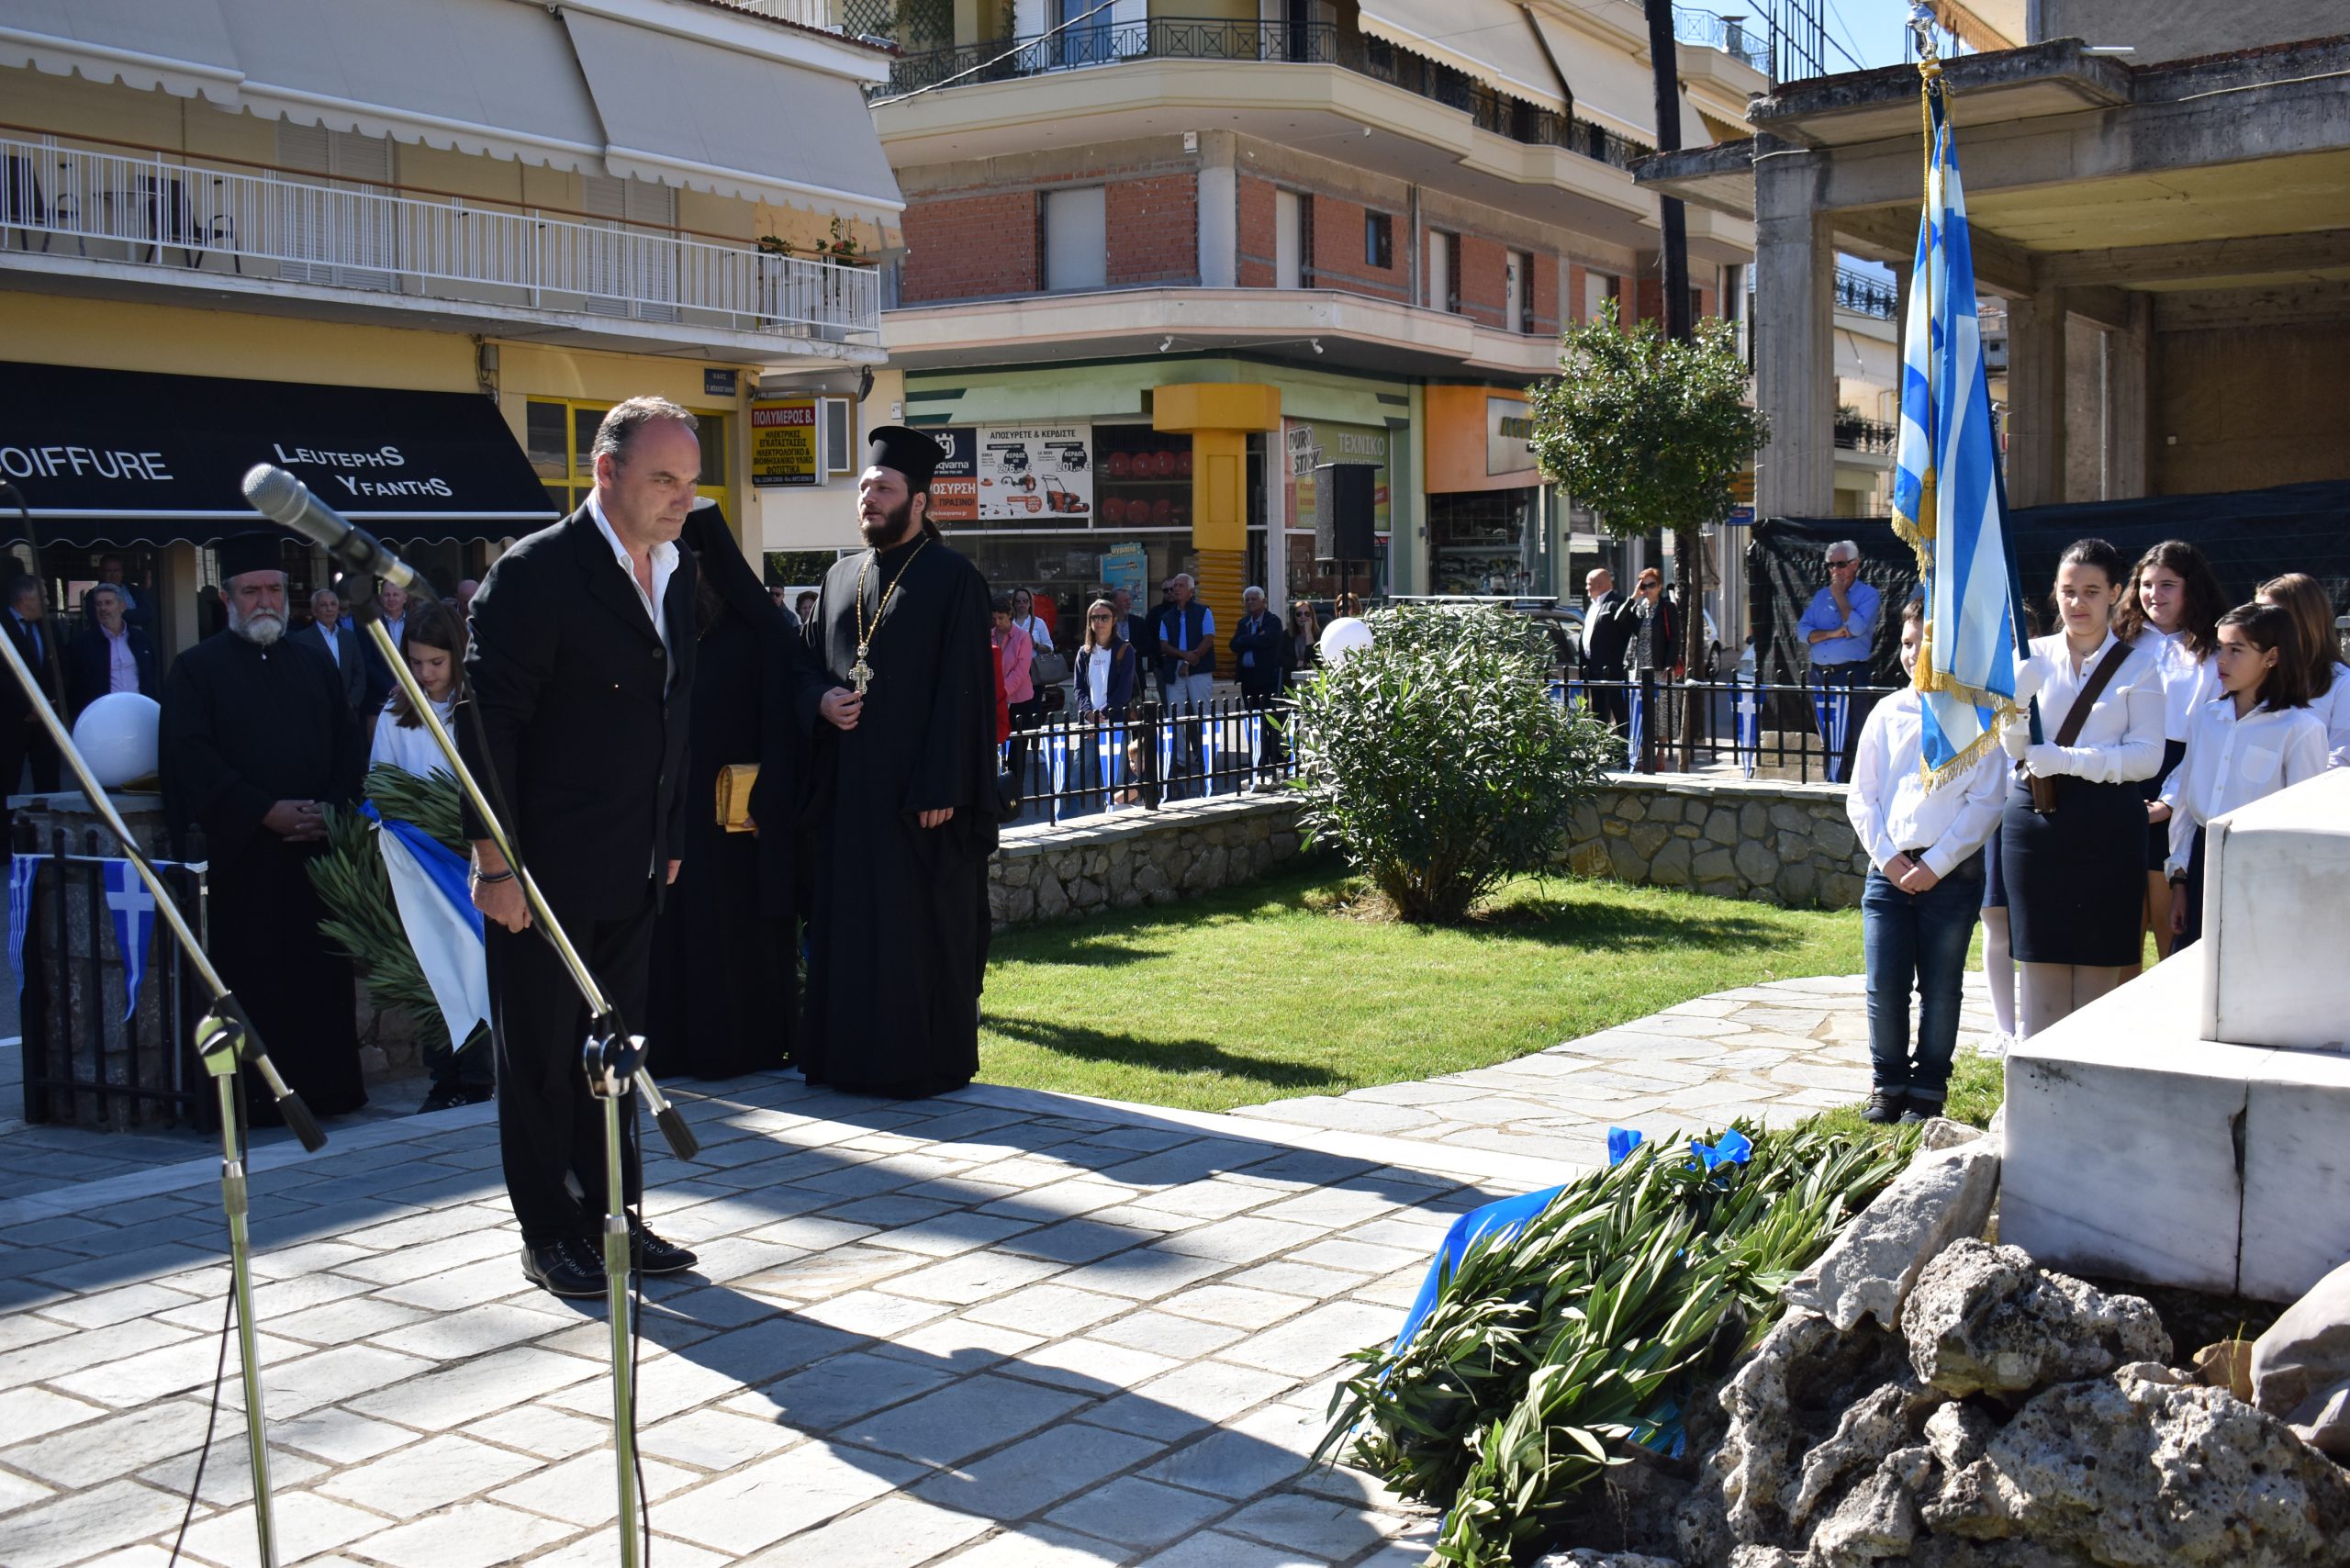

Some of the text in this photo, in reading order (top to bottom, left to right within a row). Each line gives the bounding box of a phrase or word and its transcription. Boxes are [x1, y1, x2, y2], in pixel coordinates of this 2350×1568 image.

[754, 409, 813, 426] ΠΟΛΥΜΕΡΟΣ Β.
[759, 438, 807, 447] ΕΓΚΑΤΑΣΤΑΣΕΙΣ
[765, 430, 800, 439] ΗΛΕΚΤΡΙΚΕΣ
[990, 430, 1076, 440] ΑΠΟΣΥΡΕΤΕ & ΚΕΡΔΙΣΤΕ
[1288, 427, 1314, 452] DURO
[756, 448, 805, 457] ΗΛΕΚΤΡΟΛΟΓΙΚΟ
[1337, 432, 1385, 456] ΤΕΧΝΙΚΟ
[0, 446, 174, 480] OIFFURE
[273, 443, 405, 468] LEUTEPHS
[753, 456, 795, 465] ΒΙΟΜΗΧΑΝΙΚΟ
[1293, 450, 1320, 475] STICK
[334, 475, 453, 497] YFANTHS
[930, 483, 976, 495] ΟΣΥΡΣΗ
